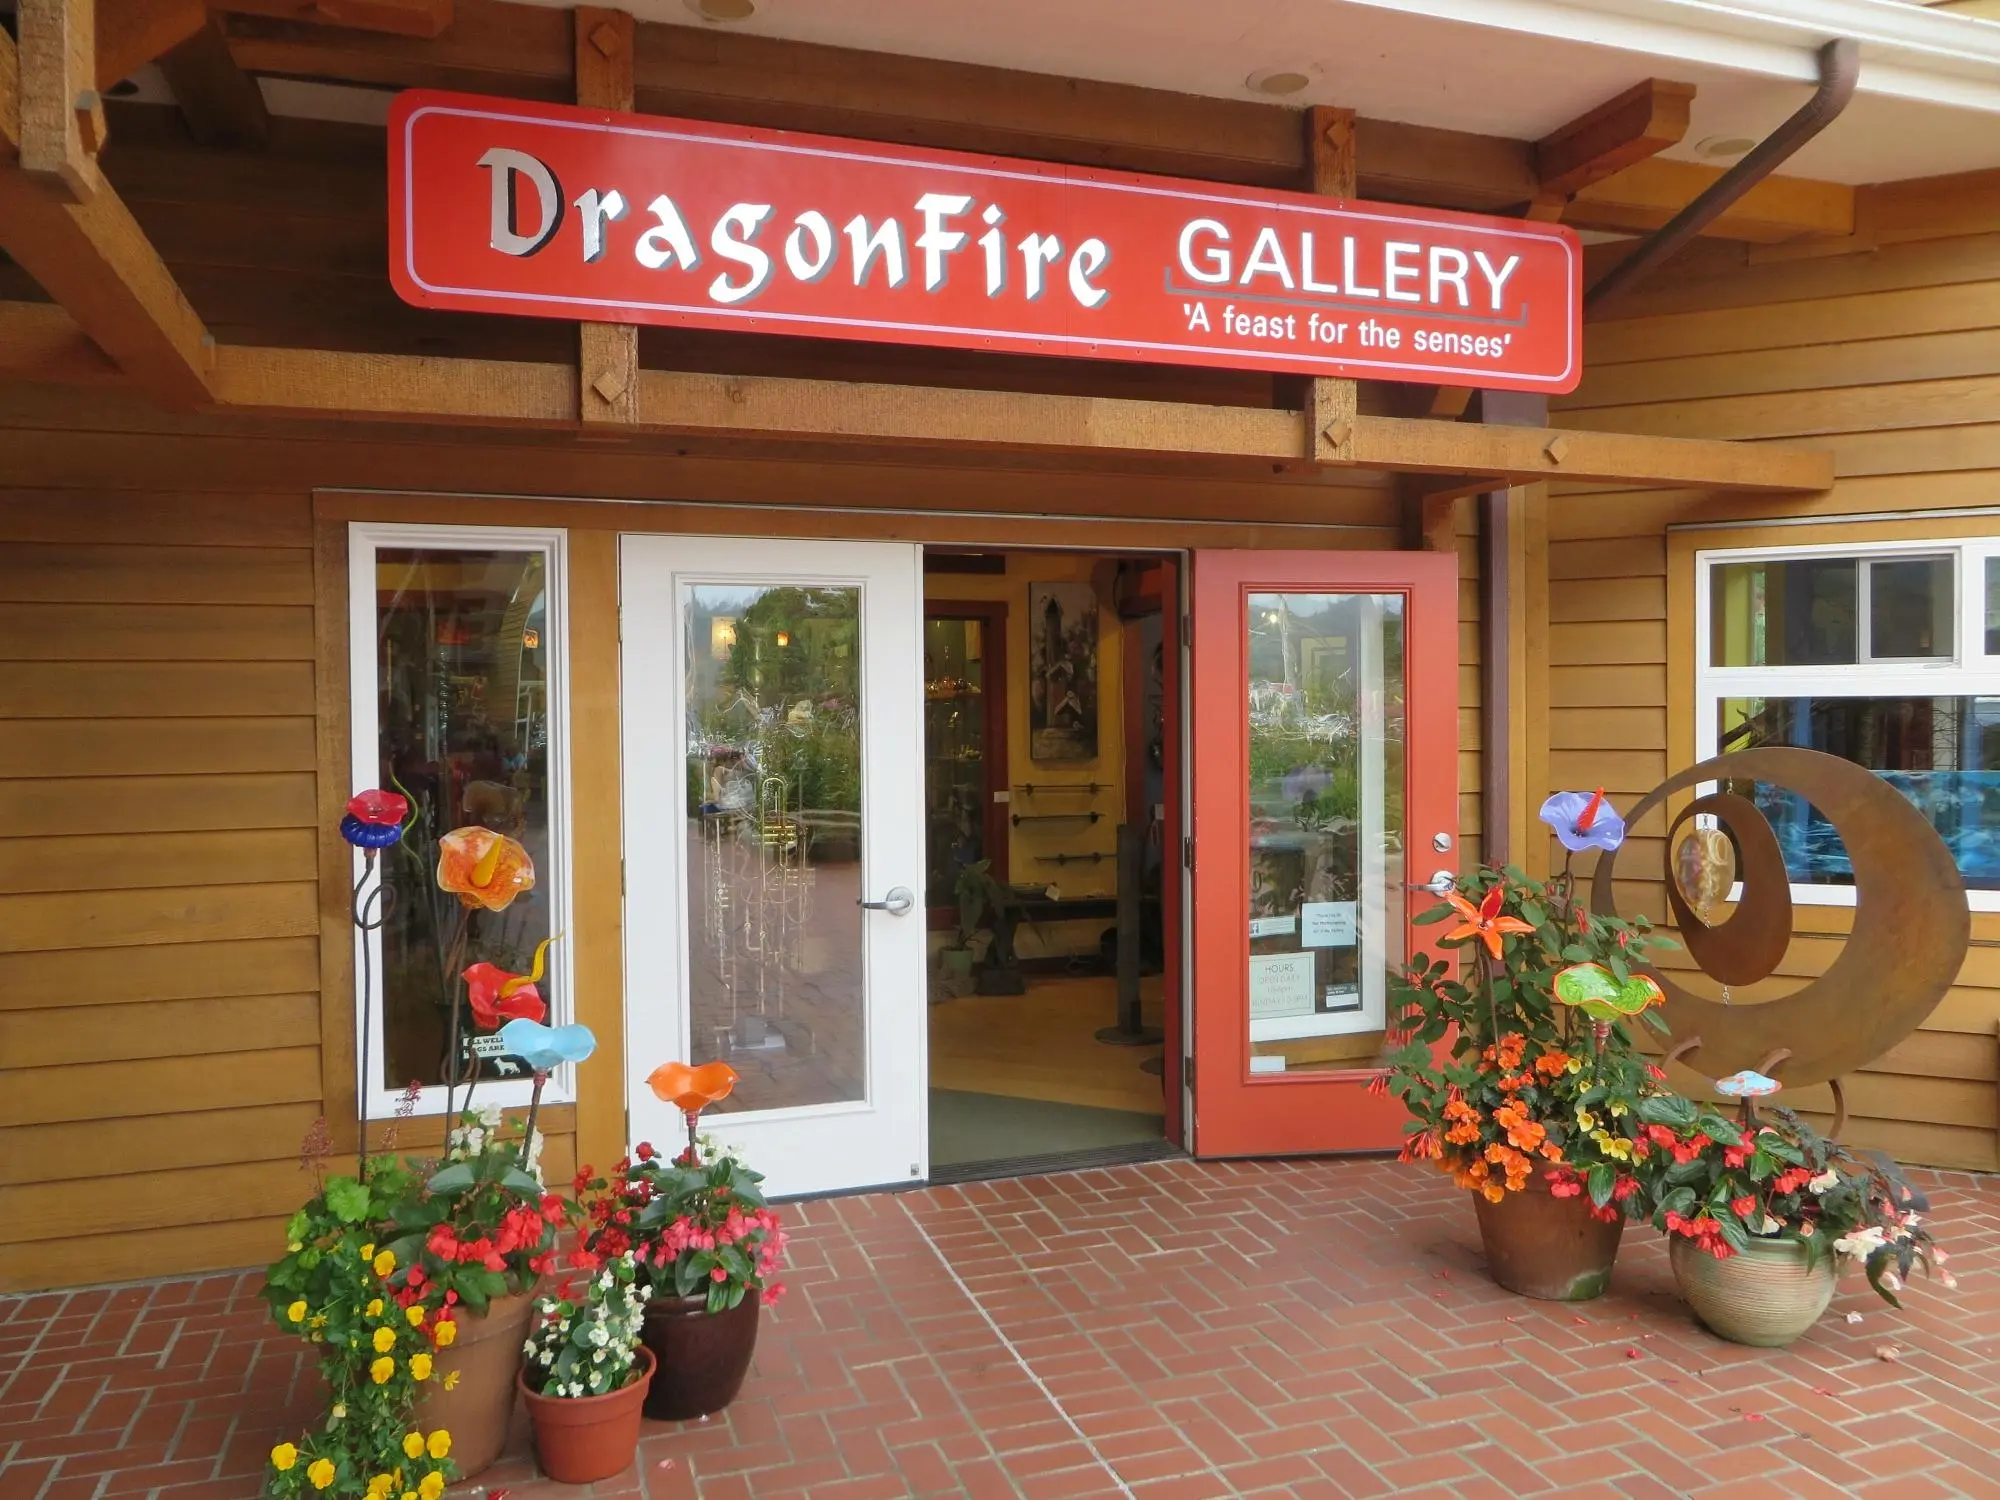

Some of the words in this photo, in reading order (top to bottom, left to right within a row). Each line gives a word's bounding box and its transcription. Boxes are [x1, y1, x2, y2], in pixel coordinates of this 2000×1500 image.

[476, 147, 1110, 308] DragonFire
[1178, 218, 1520, 311] GALLERY
[1222, 304, 1297, 340] feast
[1308, 312, 1349, 344] for
[1358, 319, 1401, 349] the
[1264, 963, 1294, 974] HOURS
